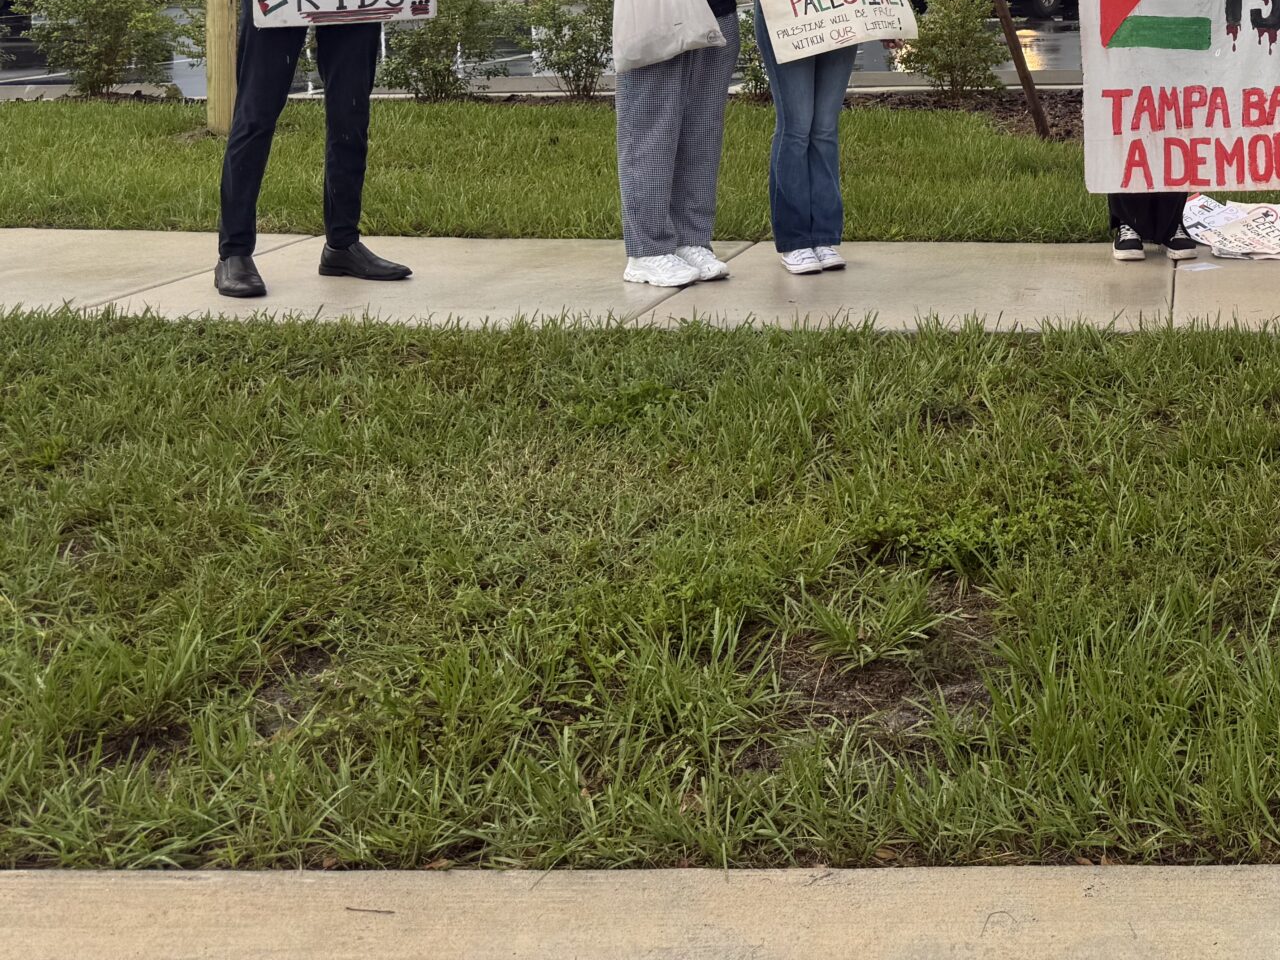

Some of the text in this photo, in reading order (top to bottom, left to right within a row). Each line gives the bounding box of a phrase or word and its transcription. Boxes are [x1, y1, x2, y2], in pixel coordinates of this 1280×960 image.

[776, 18, 825, 39] PALESTINE
[830, 13, 849, 25] WILL
[855, 8, 868, 19] BE
[792, 32, 825, 51] WITHIN
[829, 26, 856, 41] OUR
[1102, 85, 1231, 136] TAMPA
[1120, 141, 1154, 189] A
